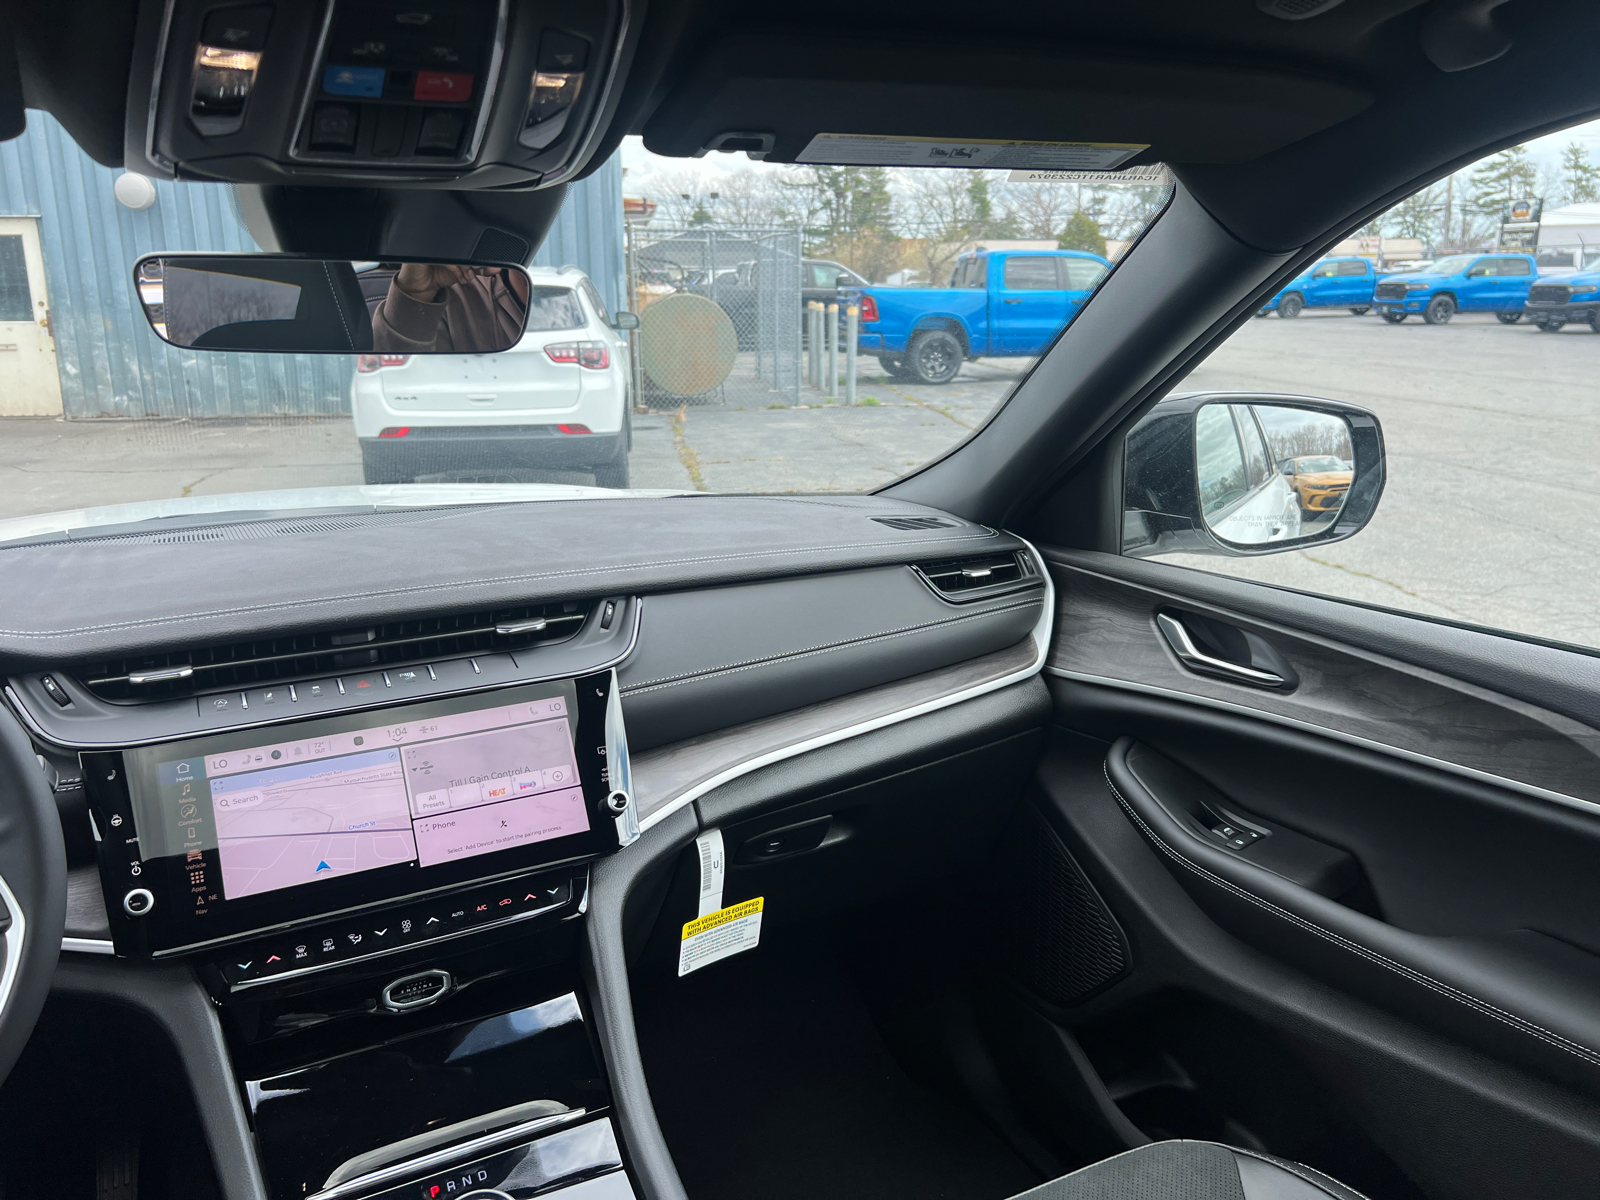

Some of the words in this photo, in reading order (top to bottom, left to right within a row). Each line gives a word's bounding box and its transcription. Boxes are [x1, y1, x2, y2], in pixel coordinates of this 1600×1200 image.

[549, 702, 562, 712] LO
[386, 727, 408, 738] 1:04
[213, 759, 228, 770] LO
[176, 775, 194, 783] Home
[449, 778, 463, 788] Till
[469, 774, 490, 784] Gain
[490, 766, 523, 780] Control
[488, 787, 507, 797] HEAT
[232, 794, 259, 805] Search
[422, 800, 445, 810] Presets
[178, 818, 203, 827] Comfort
[348, 822, 370, 831] Church
[432, 820, 456, 831] Phone
[183, 840, 203, 848] Phone
[447, 846, 463, 854] Select
[502, 835, 515, 843] start
[524, 830, 542, 840] pairing
[185, 862, 207, 871] Vehicle
[476, 904, 488, 912] A/C
[451, 910, 464, 918] AUTO
[687, 921, 701, 930] THIS
[701, 911, 725, 924] VEHICLE
[732, 900, 760, 913] EQUIPPED
[686, 927, 702, 937] WITH
[702, 915, 733, 930] ADVANCED
[733, 911, 743, 919] AIR
[743, 907, 759, 915] BAGS
[295, 952, 308, 960] MAX
[430, 1185, 440, 1198] P
[446, 1180, 456, 1192] R
[461, 1174, 473, 1187] N
[477, 1170, 488, 1182] D
